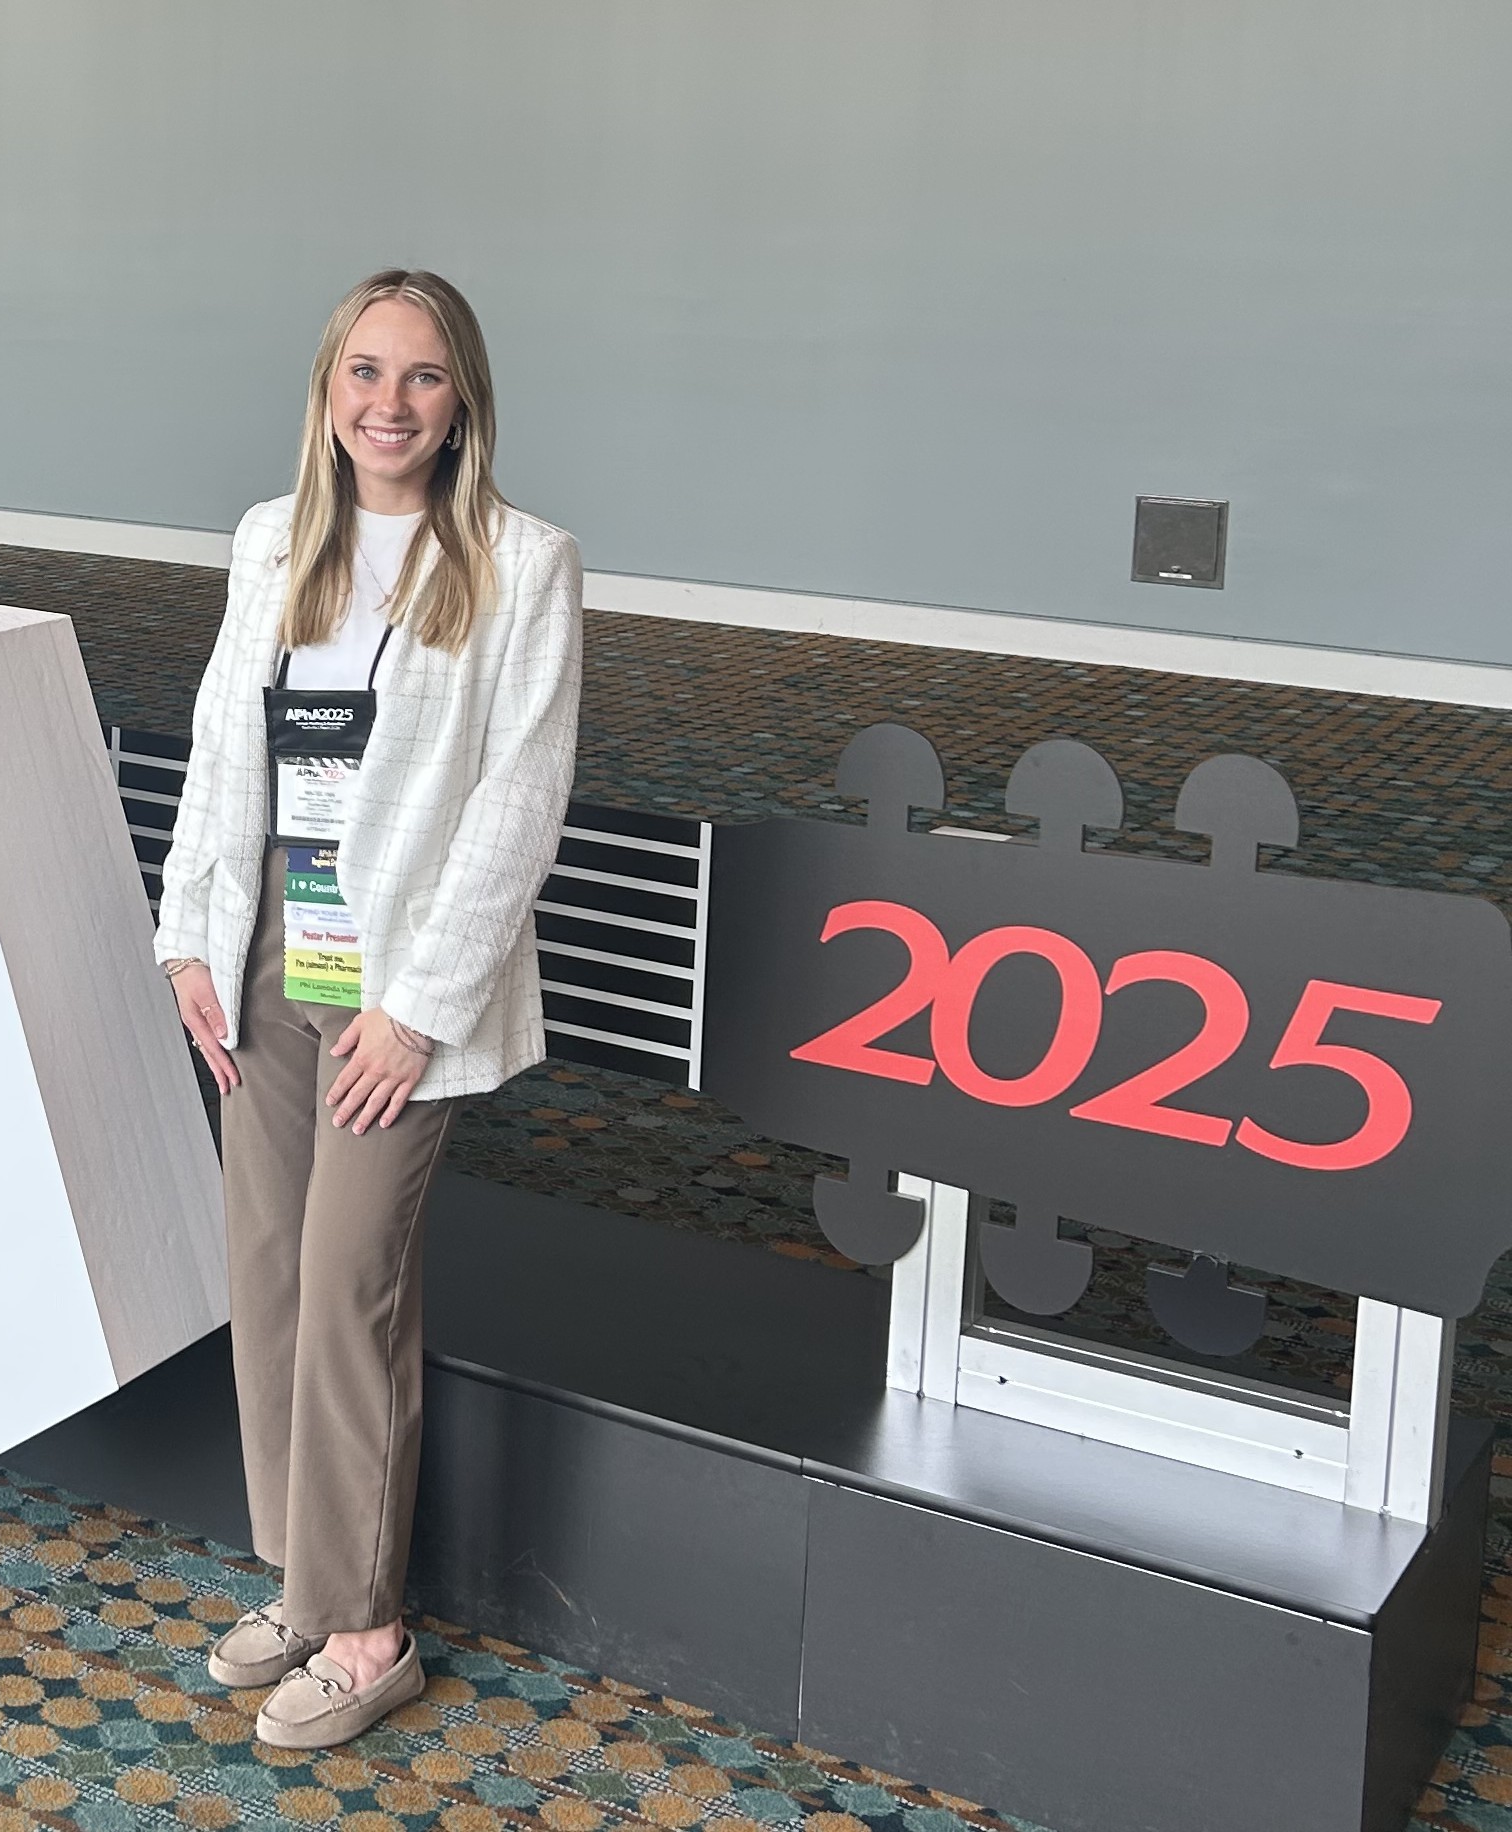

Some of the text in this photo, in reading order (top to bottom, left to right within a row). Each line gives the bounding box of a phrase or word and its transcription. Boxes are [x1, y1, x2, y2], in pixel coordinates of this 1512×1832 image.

[285, 708, 354, 721] APhA2025
[309, 881, 338, 893] Countr
[302, 929, 359, 943] Poster Presenter
[789, 899, 1442, 1171] 2025
